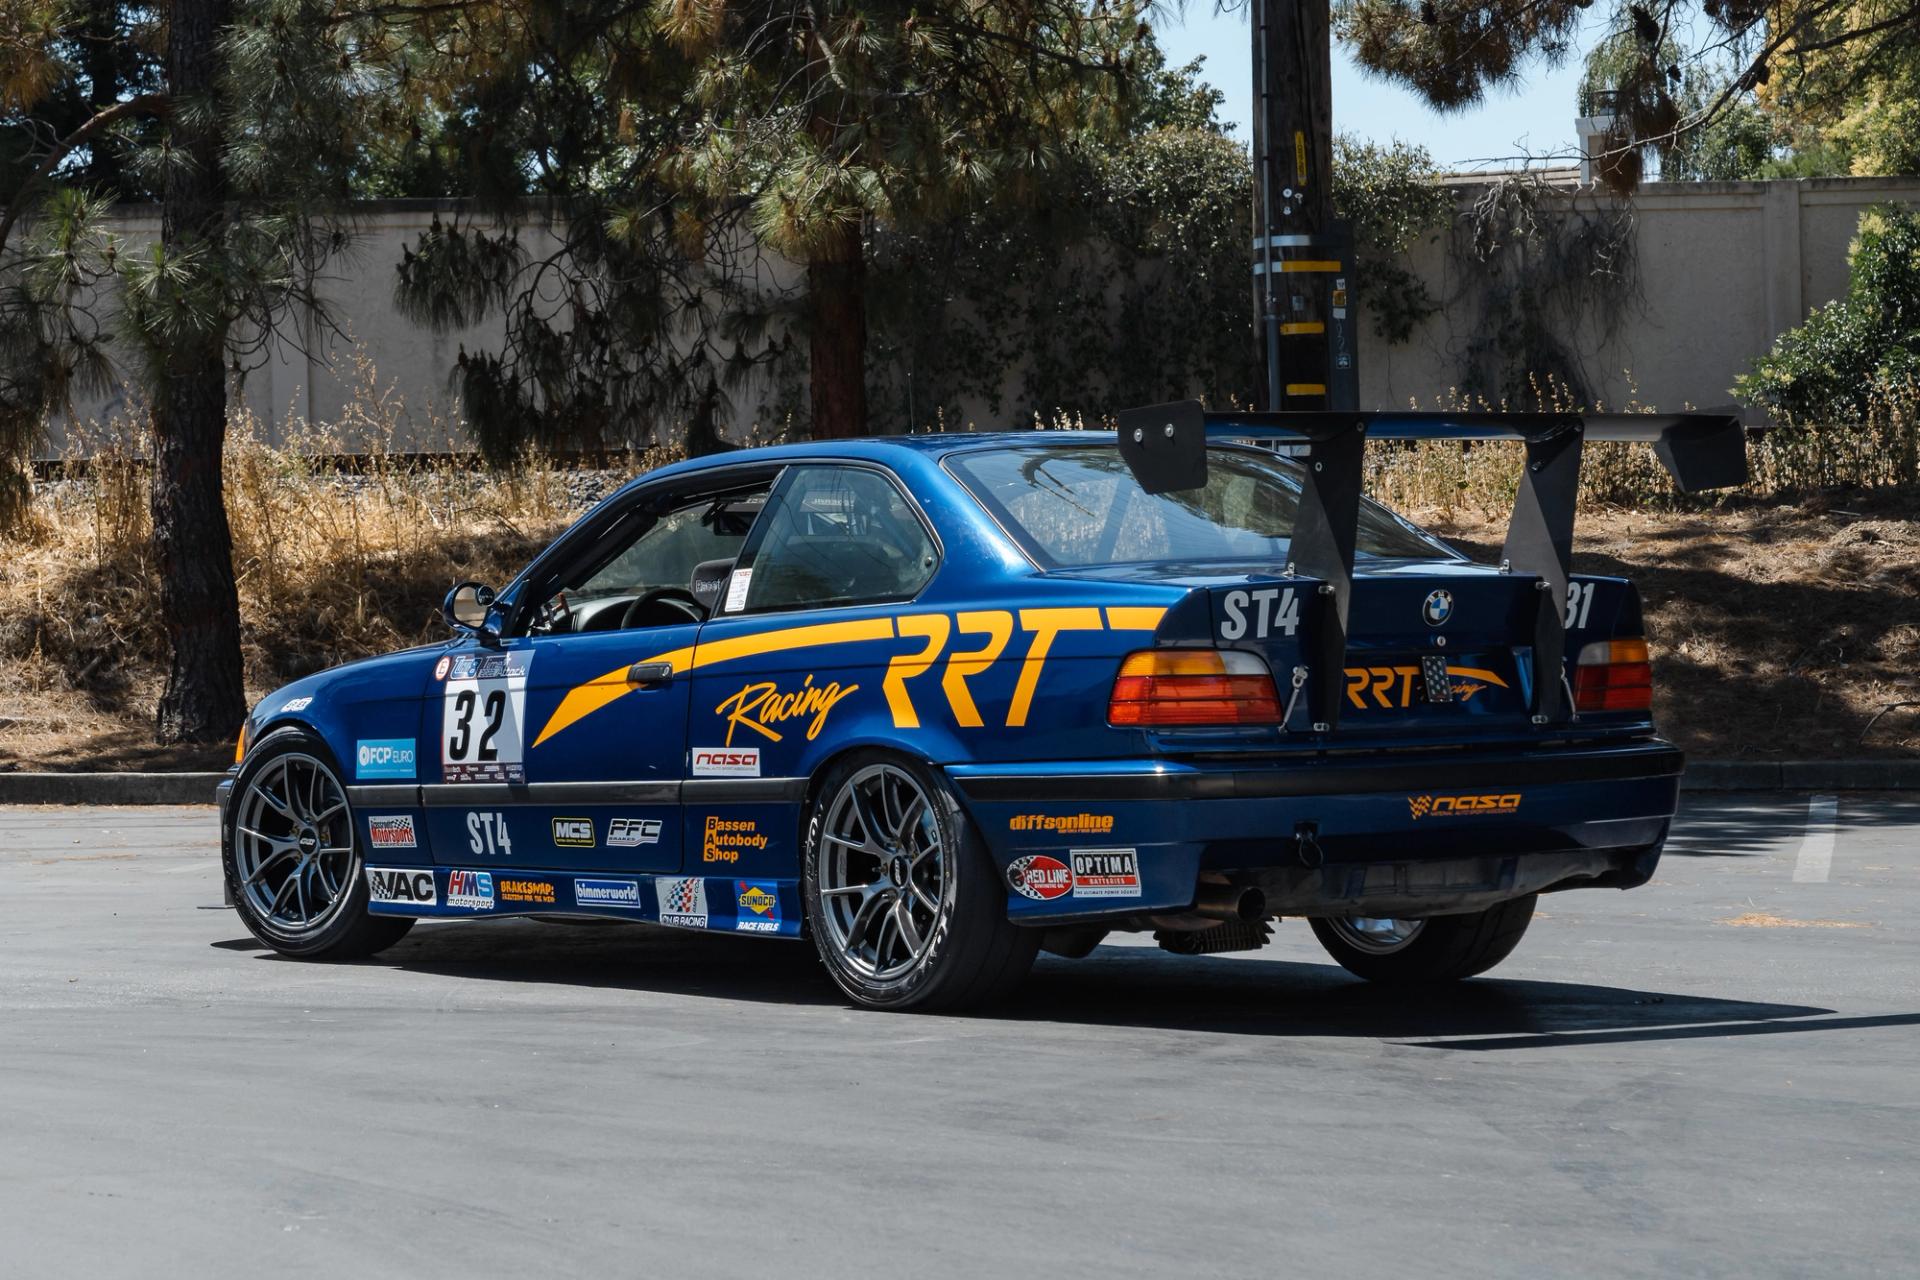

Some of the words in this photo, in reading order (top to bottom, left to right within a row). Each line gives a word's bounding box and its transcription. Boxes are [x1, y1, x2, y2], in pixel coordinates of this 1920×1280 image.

[1221, 588, 1299, 640] ST4
[883, 607, 1104, 728] RRT
[1343, 666, 1420, 709] RRT
[716, 674, 859, 747] Racing
[449, 690, 506, 762] 32
[370, 747, 391, 764] FCP
[393, 750, 414, 764] EURO
[696, 753, 758, 766] nasa
[1432, 794, 1521, 811] nasa
[610, 820, 662, 837] PFC
[708, 818, 756, 832] Bassen
[1010, 813, 1114, 830] diffsonline
[466, 812, 512, 854] ST4
[556, 822, 592, 839] MCS
[706, 832, 769, 850] Autobody
[706, 847, 740, 864] Shop
[1075, 856, 1134, 874] OPTIMA
[1046, 868, 1070, 884] LINE
[372, 870, 434, 902] VAC
[448, 872, 493, 898] HMS
[576, 883, 637, 900] bimmerworld
[448, 898, 494, 909] motorsport
[741, 895, 774, 906] SUNOCO
[680, 916, 705, 928] RACING
[737, 921, 757, 930] RACE
[757, 922, 780, 931] FUELS
